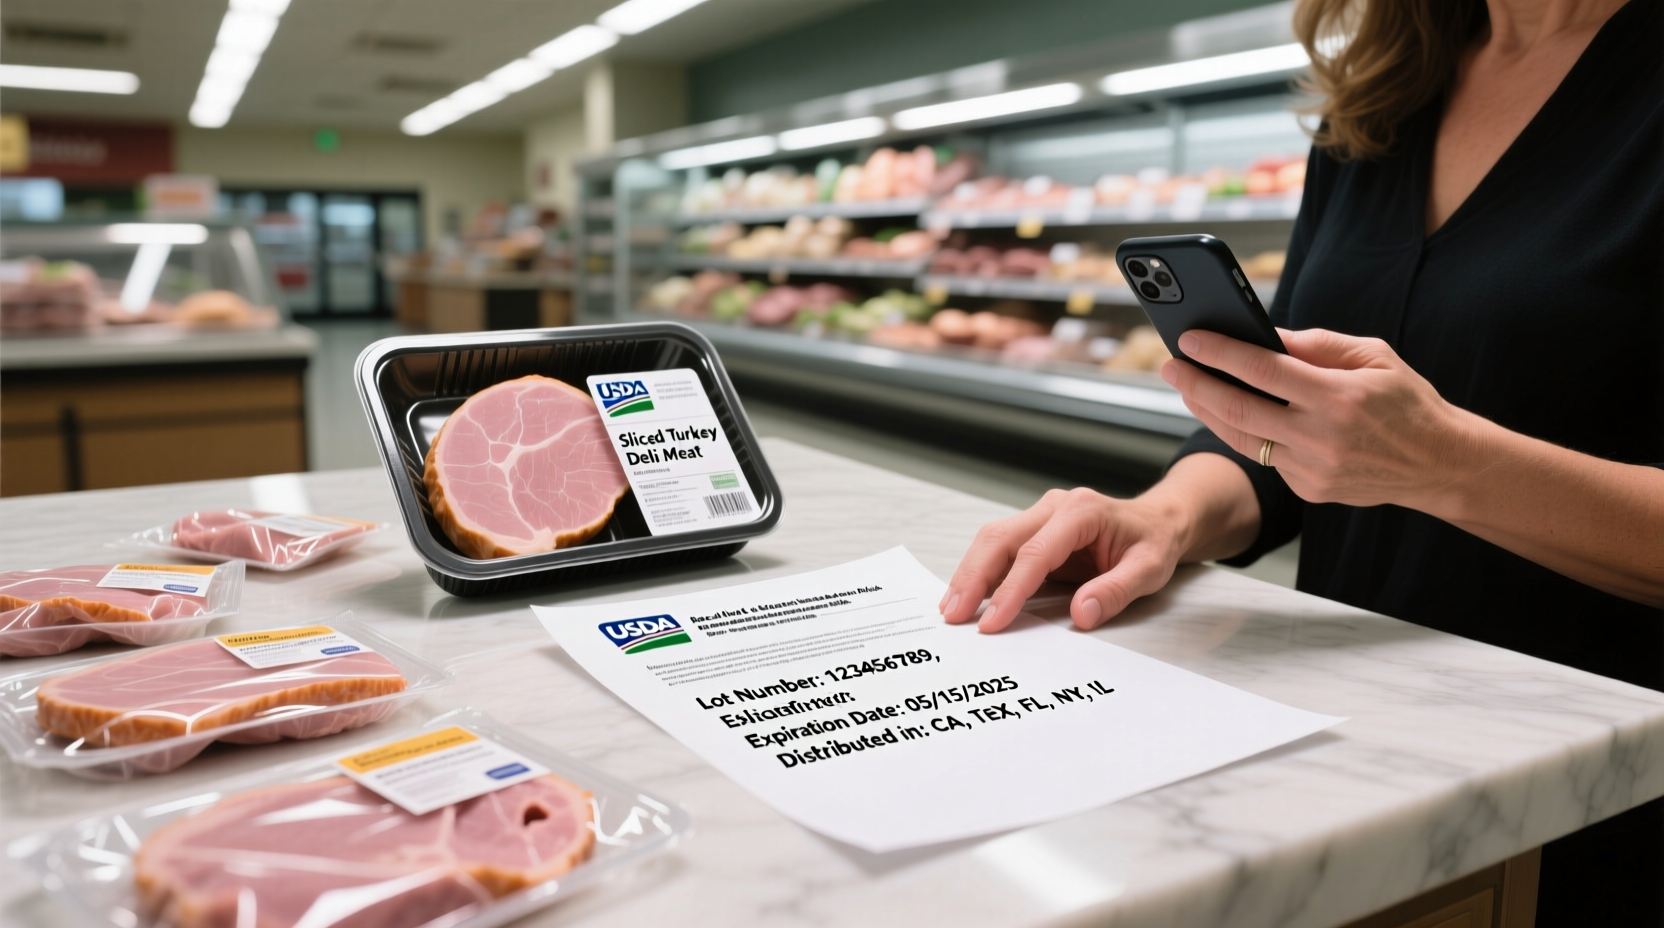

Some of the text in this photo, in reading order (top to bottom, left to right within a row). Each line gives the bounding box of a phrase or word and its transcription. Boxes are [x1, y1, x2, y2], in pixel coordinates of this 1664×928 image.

[600, 381, 649, 399] USDA
[619, 425, 717, 448] Sliced Turkey
[626, 445, 704, 466] Deli Meat
[605, 617, 677, 640] USDA
[696, 693, 735, 711] Lot
[733, 675, 825, 704] Number:
[825, 649, 941, 683] 123456789,
[744, 676, 1019, 749] Expiration Date: 05/15/2025
[776, 680, 1115, 769] Distributed in: CA, TEX, FL, NY, IL
